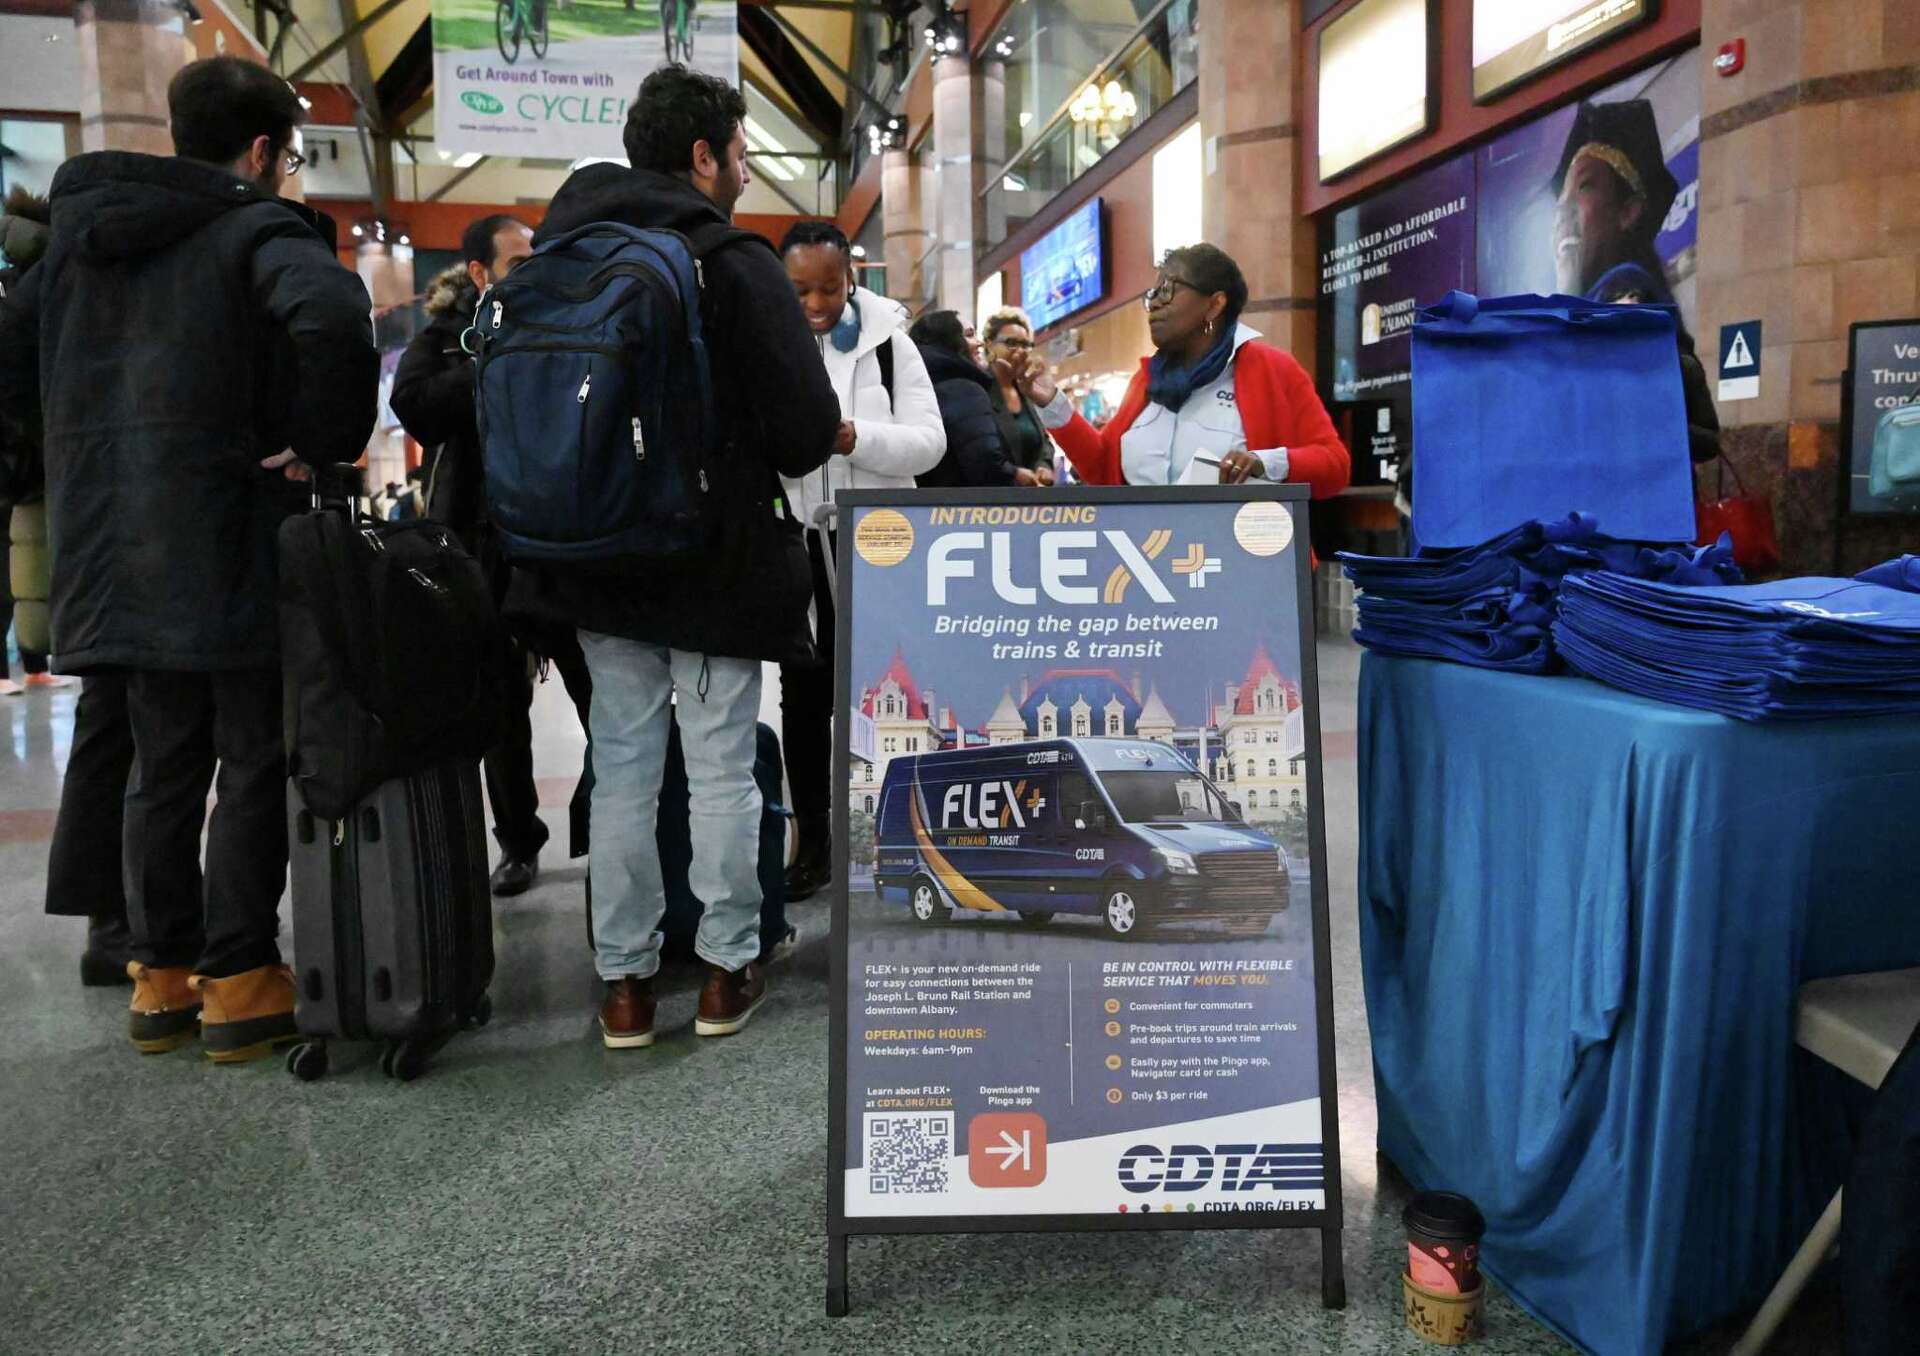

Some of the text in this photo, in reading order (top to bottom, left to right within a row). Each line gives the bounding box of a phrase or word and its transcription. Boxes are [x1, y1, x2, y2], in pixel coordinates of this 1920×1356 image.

[456, 66, 613, 87] Get Around Town with
[517, 94, 625, 125] CYCLE!
[1384, 223, 1403, 240] AND
[1404, 196, 1467, 231] AFFORDABLE
[1322, 275, 1347, 295] CLOSE
[1350, 271, 1362, 285] TO
[1872, 368, 1920, 384] Thru
[929, 506, 1096, 525] INTRODUCING
[927, 529, 1222, 606] FLEX+
[934, 613, 1218, 637] Bridging the gap between
[992, 640, 1163, 660] trains & transit
[947, 835, 1020, 847] ON DEMAND TRANSIT
[1075, 848, 1105, 860] CDTA
[901, 963, 909, 974] is
[913, 965, 934, 976] your
[938, 966, 959, 974] new
[961, 963, 1018, 973] on-demand
[1020, 962, 1041, 973] ride
[1103, 959, 1293, 973] BE IN CONTROL WITH FLEXIBLE
[865, 976, 1034, 990] for easy connections between the
[1104, 974, 1269, 987] SERVICE THAT MOVES YOU.
[865, 989, 1032, 1003] Joseph L. Bruno Rail Station and
[865, 1004, 958, 1016] downtown Albany.
[1130, 1001, 1253, 1011] Convenient for commuters
[1130, 1021, 1297, 1034] Pre-book trips around train arrivals
[865, 1028, 988, 1041] OPERATING HOURS:
[1130, 1033, 1261, 1046] and departures to save time
[864, 1045, 919, 1057] Weekdays:
[1131, 1057, 1159, 1068] Easily
[1162, 1059, 1177, 1068] pay
[1180, 1057, 1200, 1066] with
[1203, 1056, 1218, 1066] the
[1221, 1055, 1249, 1067] Pingo
[1131, 1068, 1238, 1080] Navigator card or cash
[867, 1087, 893, 1096] Learn
[895, 1086, 920, 1095] about
[980, 1085, 1040, 1095] Download the
[1131, 1090, 1208, 1102] Only $3 per ride
[866, 1098, 953, 1108] at CDTA.ORG/FLEX
[988, 1097, 1033, 1107] Pingo app
[1118, 1144, 1323, 1193] CDTA
[1204, 1199, 1316, 1212] CDTA.ORG/FLEX
